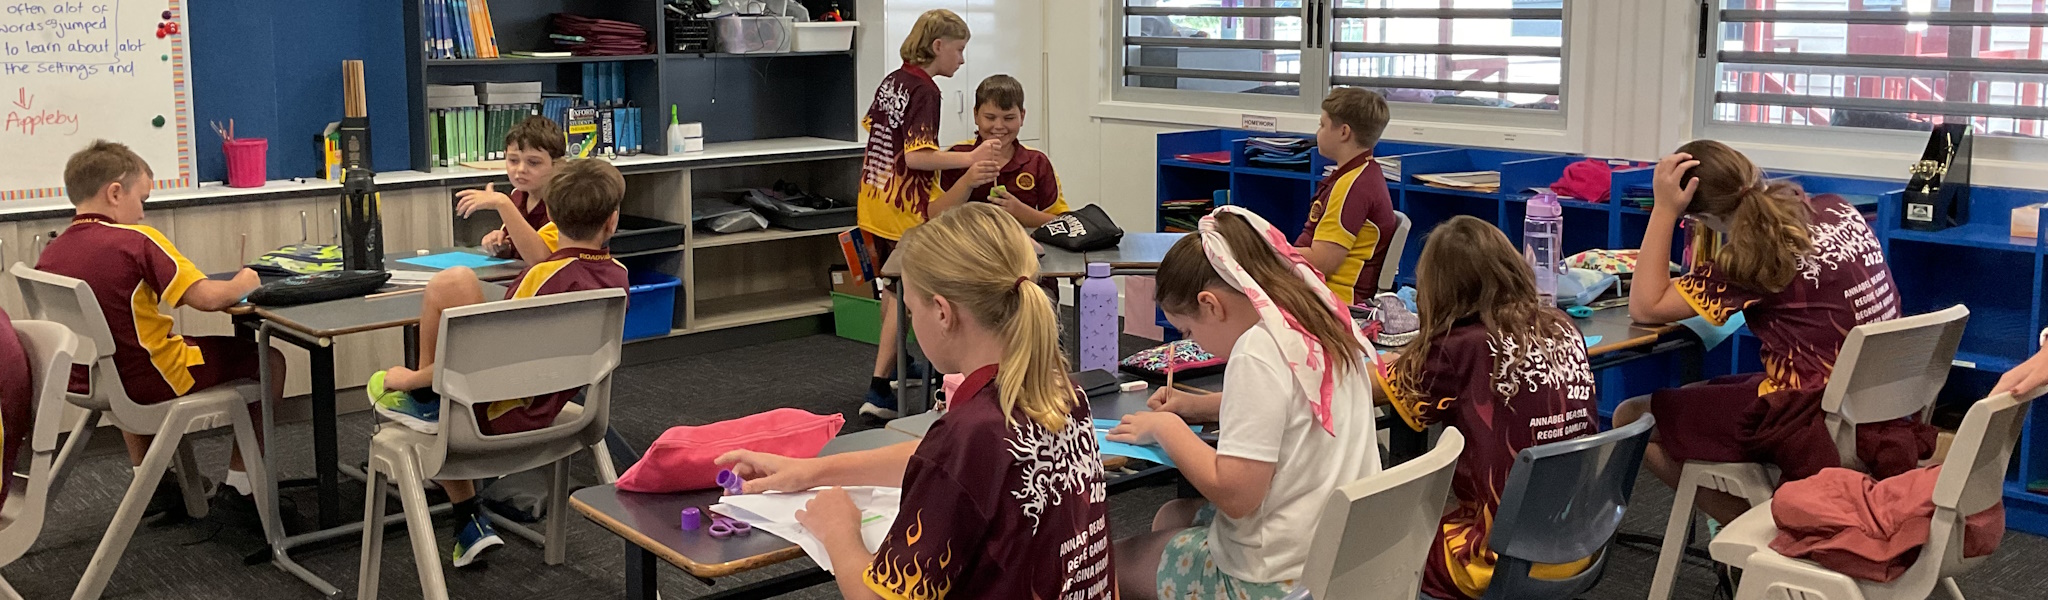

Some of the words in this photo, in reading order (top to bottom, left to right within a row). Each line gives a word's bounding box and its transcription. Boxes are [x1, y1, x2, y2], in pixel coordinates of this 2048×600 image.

[7, 3, 46, 15] often
[53, 1, 83, 14] alot
[92, 4, 109, 14] of
[55, 16, 107, 38] jumped
[5, 41, 19, 56] to
[25, 40, 62, 53] learn
[68, 39, 109, 53] about
[119, 38, 146, 52] alot
[5, 62, 30, 75] the
[37, 61, 98, 80] settings
[108, 60, 134, 77] and
[5, 109, 79, 136] Appleby
[1862, 251, 1884, 266] 2025
[1567, 384, 1590, 400] 2025
[1529, 413, 1565, 427] ANNABEL
[1537, 427, 1564, 440] REGGIE
